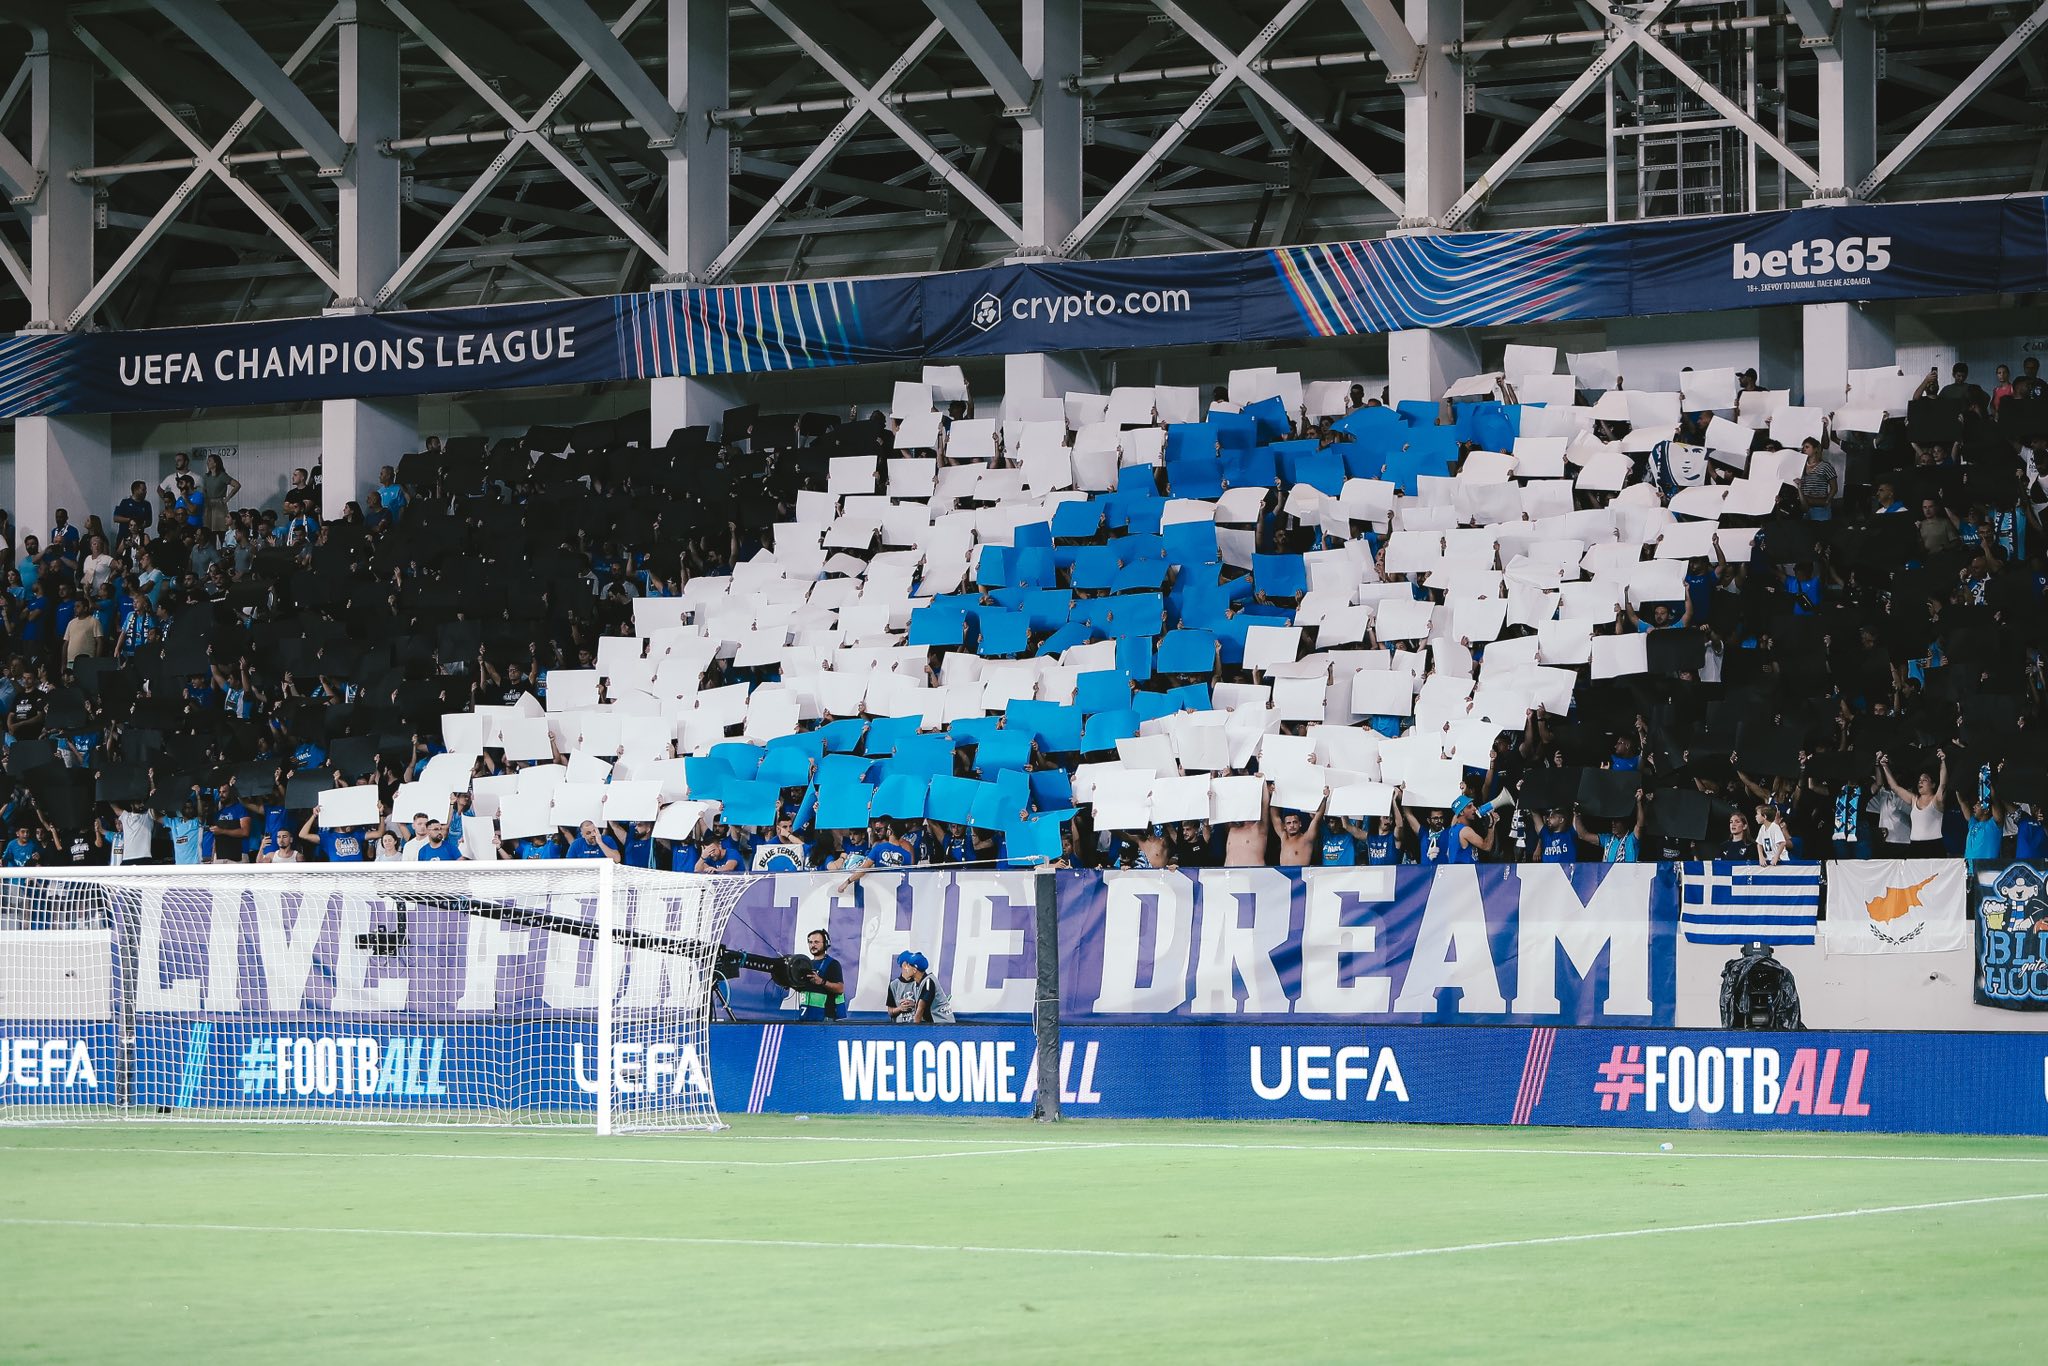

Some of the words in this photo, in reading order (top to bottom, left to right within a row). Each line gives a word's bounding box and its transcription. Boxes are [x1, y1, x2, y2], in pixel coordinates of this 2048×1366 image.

[1733, 236, 1892, 280] bet365
[1012, 289, 1191, 323] crypto.com
[119, 352, 203, 387] UEFA
[214, 337, 424, 383] CHAMPIONS
[436, 326, 576, 369] LEAGUE
[758, 849, 776, 868] BLUE
[777, 846, 802, 868] TERROR
[136, 872, 410, 1011] LIVE
[773, 870, 1038, 1013] THE
[1093, 863, 1657, 1017] DREAM
[0, 1039, 98, 1088] EFA
[238, 1037, 447, 1095] #FOOTBALL
[574, 1042, 709, 1094] UEFA
[838, 1040, 1016, 1103] WELCOME
[1250, 1045, 1409, 1102] UEFA
[1594, 1045, 1871, 1116] #FOOTBALL
